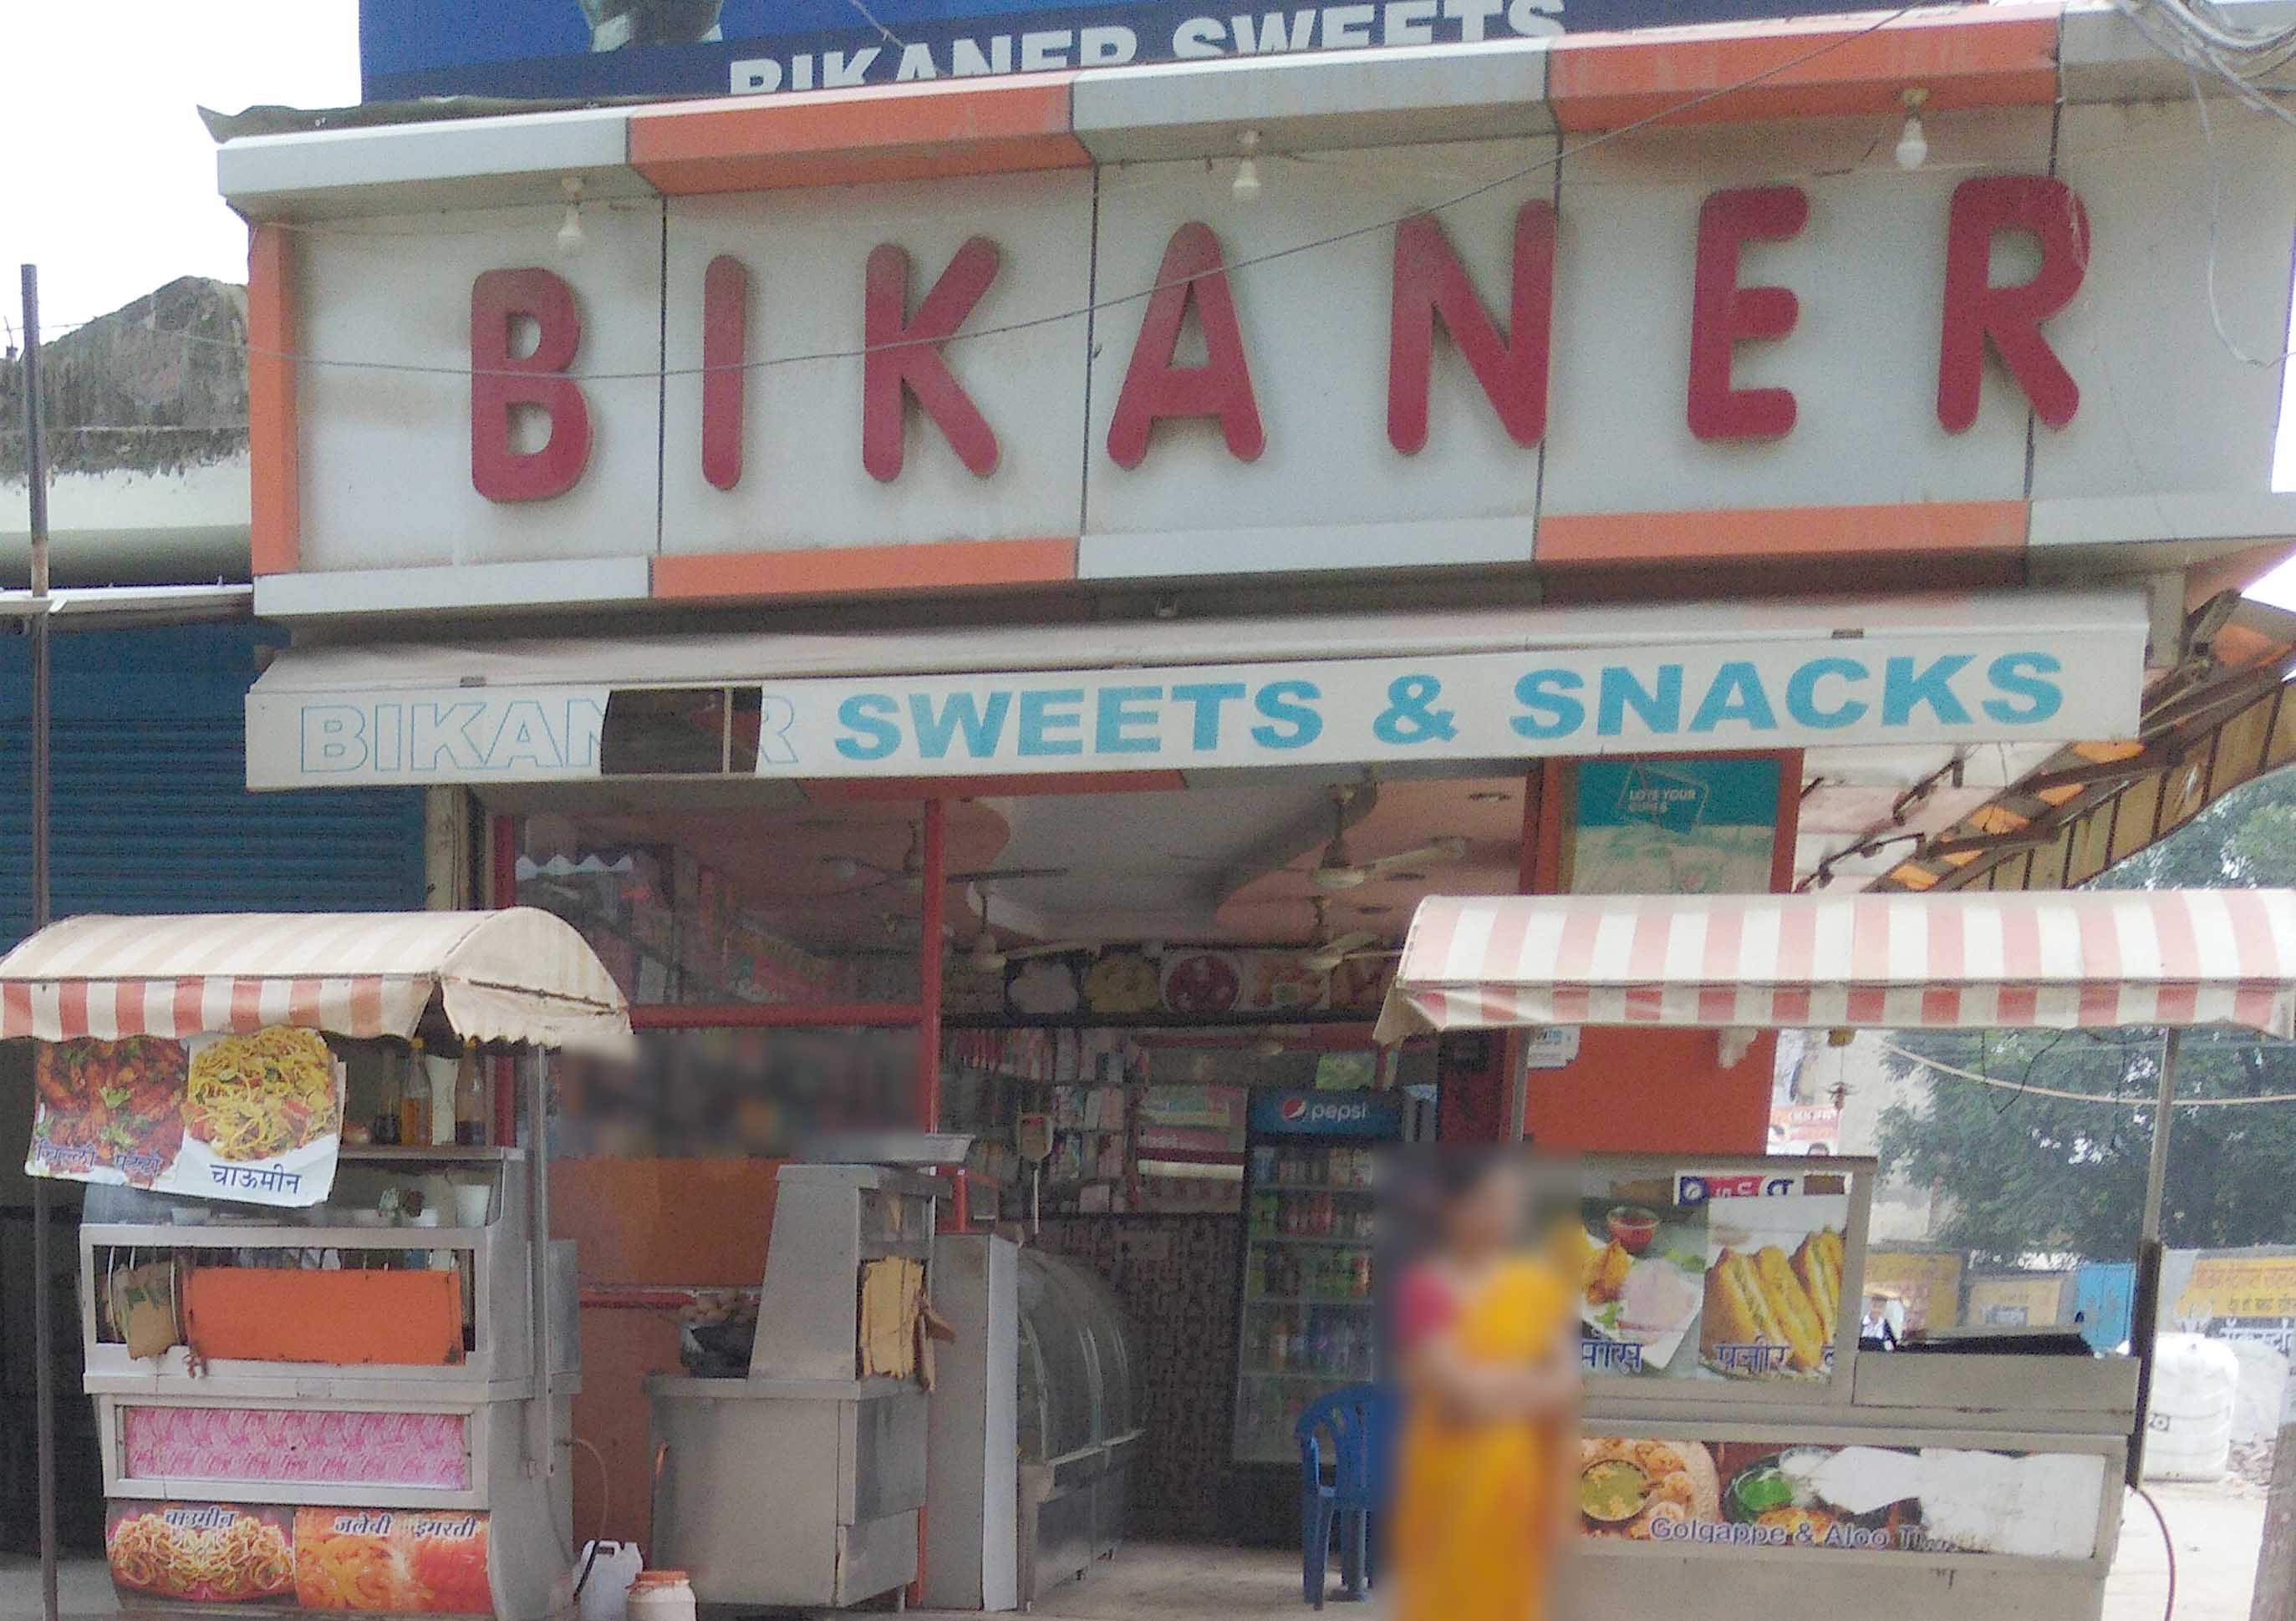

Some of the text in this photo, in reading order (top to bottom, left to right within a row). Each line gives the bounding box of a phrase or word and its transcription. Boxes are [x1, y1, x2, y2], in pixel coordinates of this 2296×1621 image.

[730, 0, 1565, 95] BIKANER SWEETS
[471, 173, 2090, 503] BIKANER
[834, 679, 1324, 760] SWEETS
[1372, 673, 1459, 744] &
[1508, 651, 2063, 740] SNACKS
[1311, 1101, 1367, 1121] pepsi
[1651, 1517, 1786, 1546] Golgappe
[1795, 1522, 1815, 1545] &
[1824, 1524, 1891, 1550] Aloo
